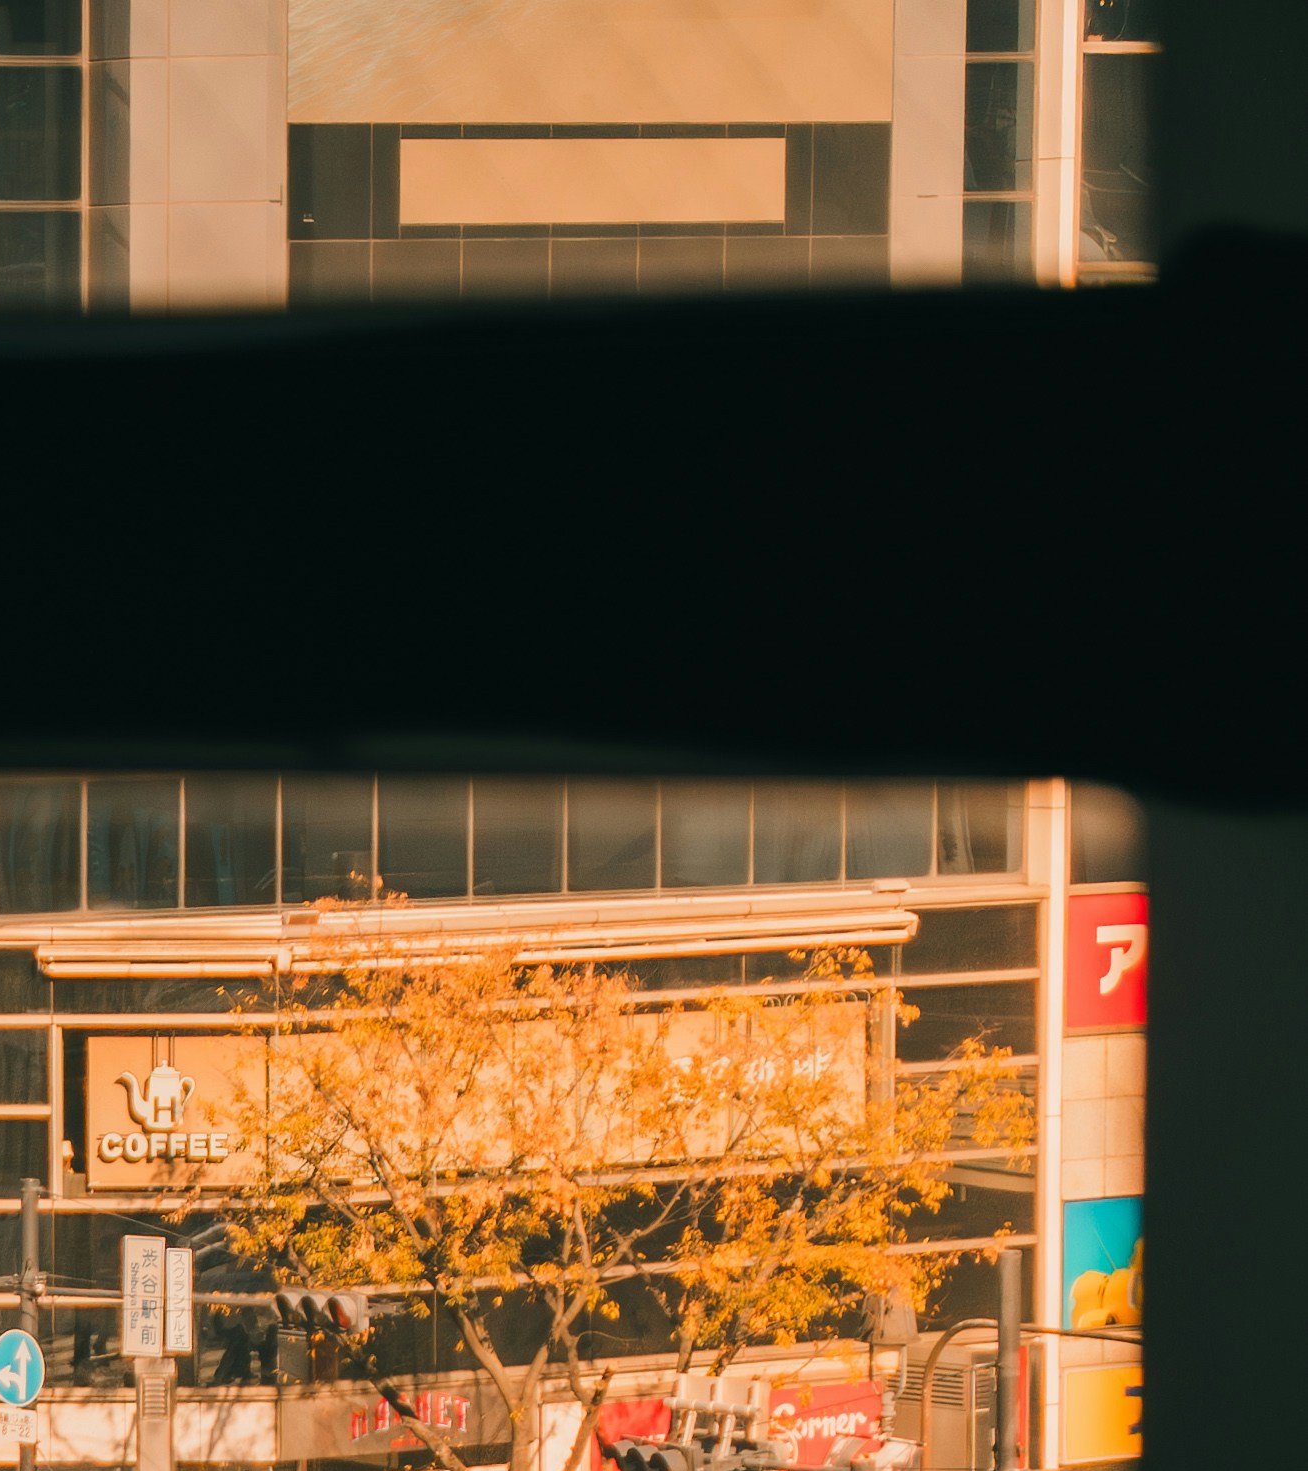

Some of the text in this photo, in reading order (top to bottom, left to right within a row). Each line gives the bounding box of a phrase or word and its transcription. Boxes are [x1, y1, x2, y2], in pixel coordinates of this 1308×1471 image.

[100, 1132, 230, 1162] COFFEE
[129, 1262, 140, 1306] Shibuya
[141, 1247, 159, 1346] 渋谷駅前
